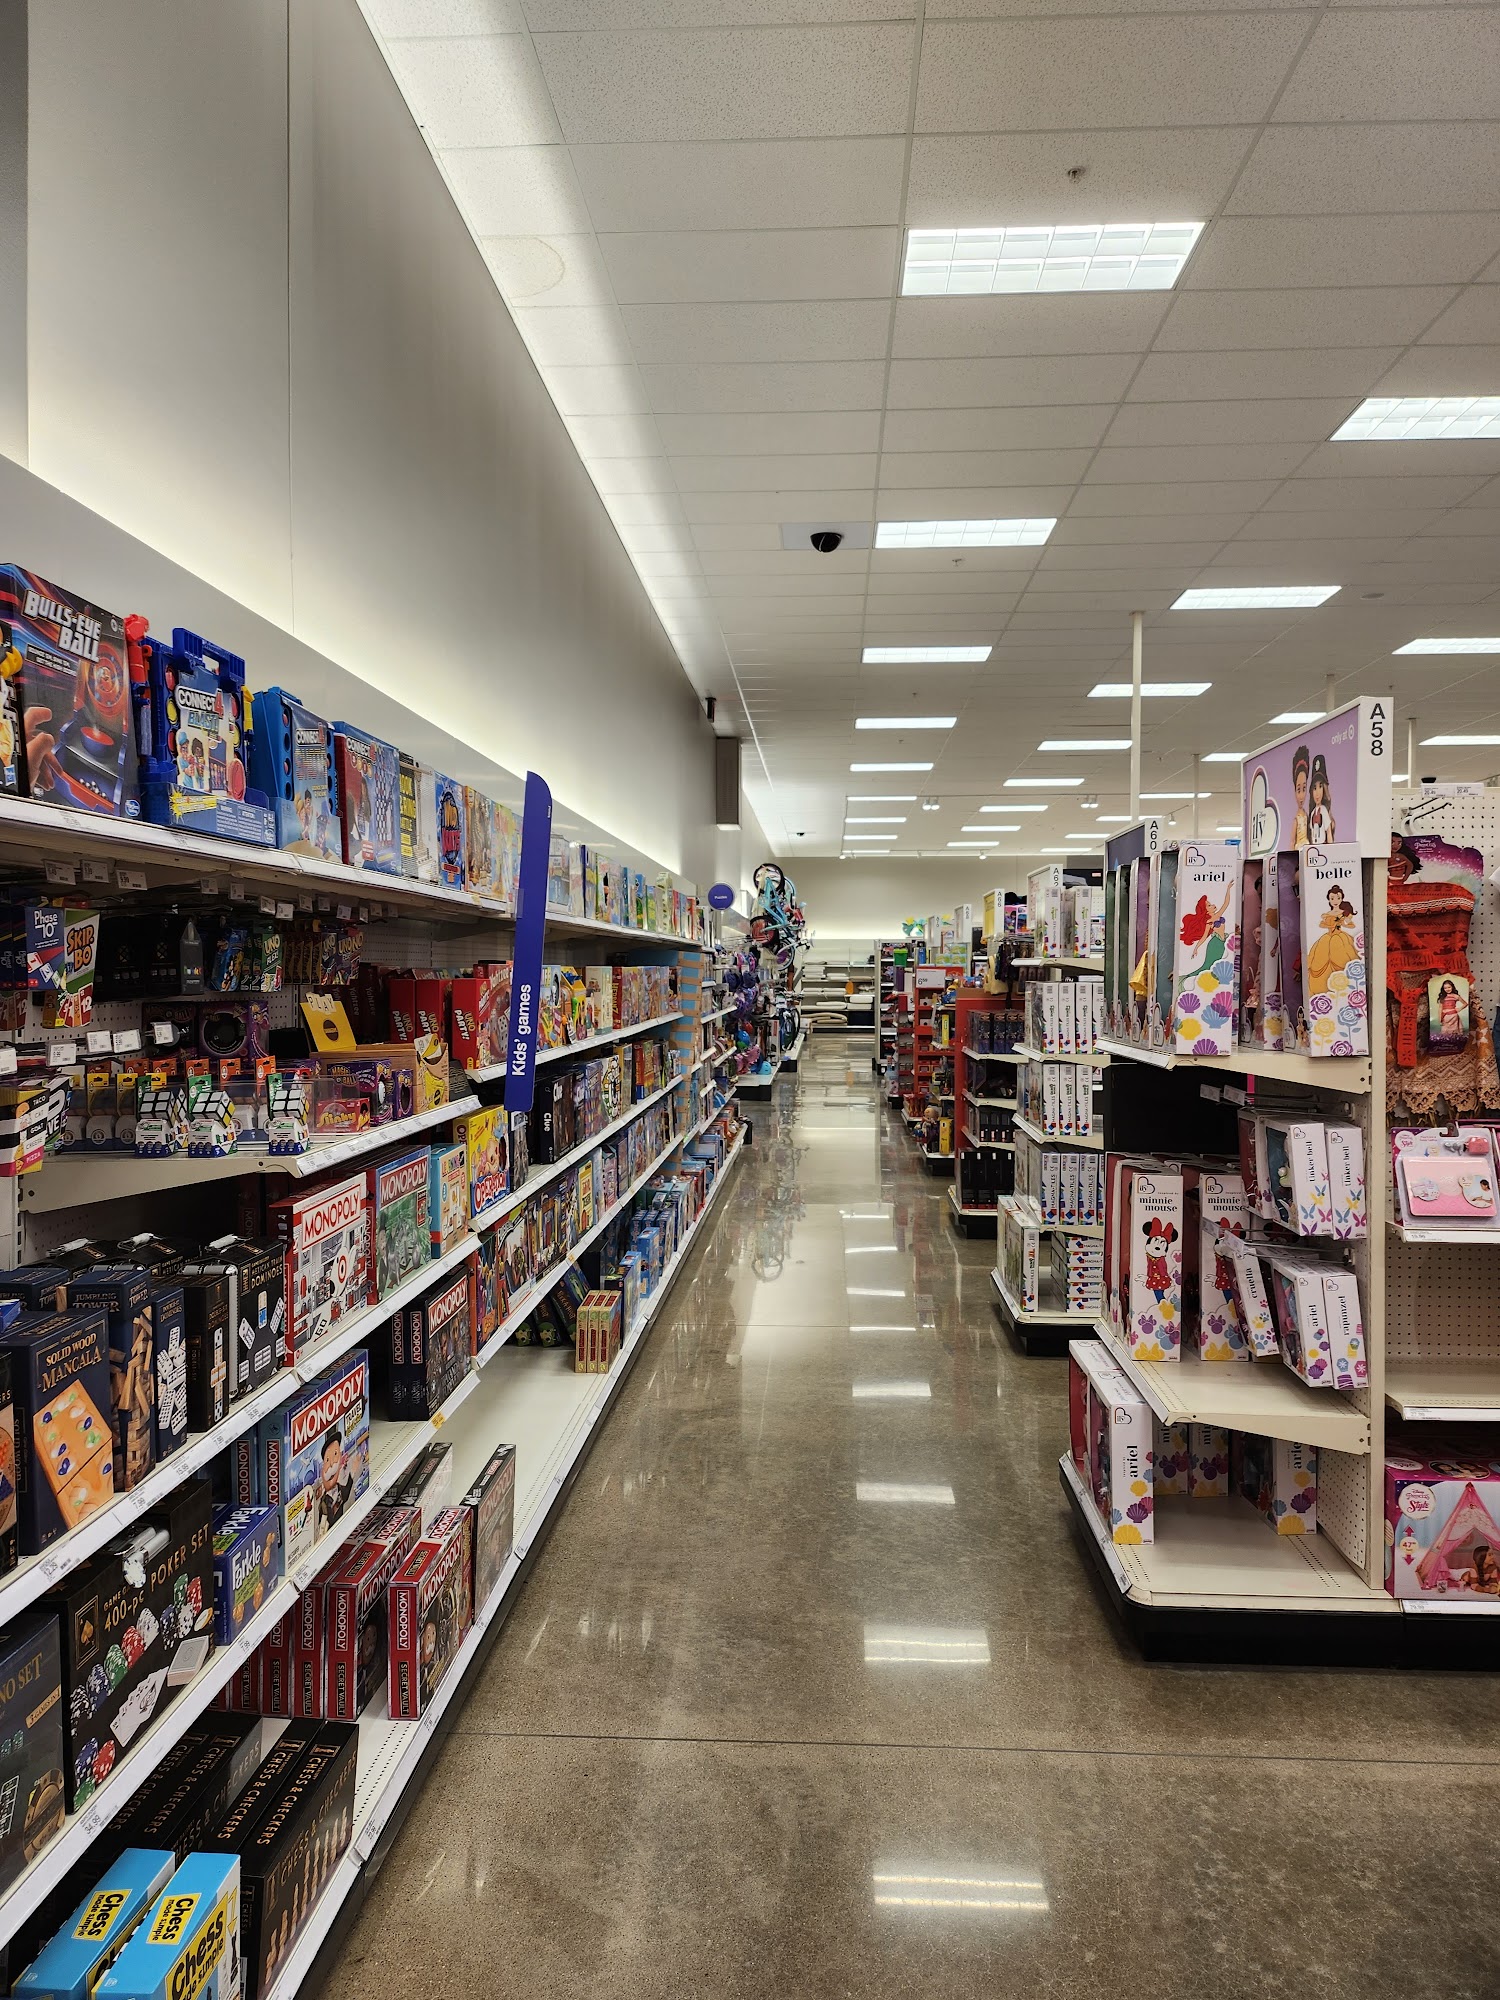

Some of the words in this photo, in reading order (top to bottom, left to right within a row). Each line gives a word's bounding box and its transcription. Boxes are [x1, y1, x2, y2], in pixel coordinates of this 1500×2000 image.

[24, 589, 101, 641] BULLS-EYE
[58, 626, 100, 663] BALL
[178, 687, 215, 711] CONNECT
[214, 689, 224, 719] 4
[296, 730, 319, 745] CONNECT
[1331, 732, 1342, 745] only
[1342, 730, 1348, 741] at
[1369, 703, 1386, 756] A58
[347, 737, 371, 759] CONNECT
[1149, 820, 1159, 850] A60
[1252, 812, 1266, 847] ily
[1188, 856, 1198, 865] ily
[1308, 856, 1319, 866] ily
[1316, 867, 1352, 880] belle
[1193, 871, 1226, 882] ariel
[34, 910, 59, 926] Phase
[40, 923, 56, 939] 10
[74, 945, 93, 972] BO
[263, 934, 281, 955] UNO
[428, 1012, 440, 1033] UNO
[464, 1011, 476, 1032] UNO
[516, 983, 532, 1035] games
[392, 1010, 408, 1041] PARTY!
[454, 1009, 471, 1040] PARTY!
[511, 1038, 527, 1076] Kids'
[32, 1094, 47, 1106] TACO
[34, 1108, 44, 1119] CAT
[30, 1122, 45, 1135] GOAT
[317, 1111, 356, 1128] Slinky
[543, 1112, 552, 1132] Clue
[26, 1151, 41, 1164] PIZZA
[1305, 1141, 1313, 1156] bell
[1342, 1145, 1350, 1161] bell
[380, 1161, 428, 1204] MONOPOLY
[1306, 1157, 1316, 1182] tinker
[1343, 1161, 1352, 1187] tinker
[1139, 1196, 1173, 1205] minnie
[1145, 1204, 1178, 1213] mouse
[1207, 1196, 1241, 1205] minnie
[1213, 1204, 1246, 1213] mouse
[304, 1192, 361, 1244] MONOPOLY
[251, 1263, 283, 1291] DOMINOES
[1245, 1267, 1258, 1299] cruella
[129, 1289, 149, 1309] TOWER
[430, 1281, 468, 1334] MONOPOLY
[315, 1319, 328, 1337] GO
[1308, 1304, 1319, 1327] ariel
[1338, 1295, 1351, 1336] rapunzel
[45, 1346, 73, 1367] SOLID
[72, 1332, 98, 1353] WOOD
[394, 1312, 403, 1364] MONOPOLY
[412, 1312, 421, 1364] MONOPOLY
[41, 1345, 103, 1393] MANCALA
[294, 1370, 363, 1451] MONOPOLY
[1126, 1445, 1138, 1478] ariel
[1291, 1442, 1302, 1469] arie
[239, 1442, 250, 1506] MONOPOLY
[268, 1441, 278, 1506] MONOPOLY
[215, 1506, 269, 1536] Farkle
[1406, 1501, 1430, 1513] Style
[150, 1545, 187, 1592] POKER
[191, 1523, 209, 1554] SET
[232, 1539, 261, 1591] Farkle
[363, 1534, 410, 1613] MONOPOLY
[422, 1536, 461, 1610] MONOPOLY
[303, 1592, 314, 1648] MONOPOLY
[338, 1593, 347, 1650] MONOPOLY
[398, 1591, 408, 1649] MONOPOLY
[18, 1652, 43, 1690] SET
[304, 1662, 312, 1690] SECRET
[273, 1687, 281, 1712] VAULT
[304, 1690, 312, 1715] VAULT
[337, 1691, 346, 1716] VAULT
[401, 1690, 409, 1716] VAULT
[191, 1747, 221, 1776] CHESS
[259, 1751, 287, 1781] CHESS
[295, 1757, 322, 1786] CHESS
[184, 1775, 198, 1784] &
[289, 1786, 303, 1794] &
[318, 1749, 357, 1823] CHECKERS
[144, 1784, 191, 1834] CHECKERS
[217, 1788, 261, 1840] CHECKERS
[256, 1794, 298, 1846] CHECKERS
[87, 1893, 124, 1937] Chess
[91, 1894, 106, 1913] made
[161, 1899, 176, 1918] made
[77, 1912, 96, 1938] simple
[152, 1917, 166, 1942] simple
[161, 1898, 194, 1941] Chess
[171, 1910, 224, 2000] Chess
[197, 1937, 224, 1981] simple
